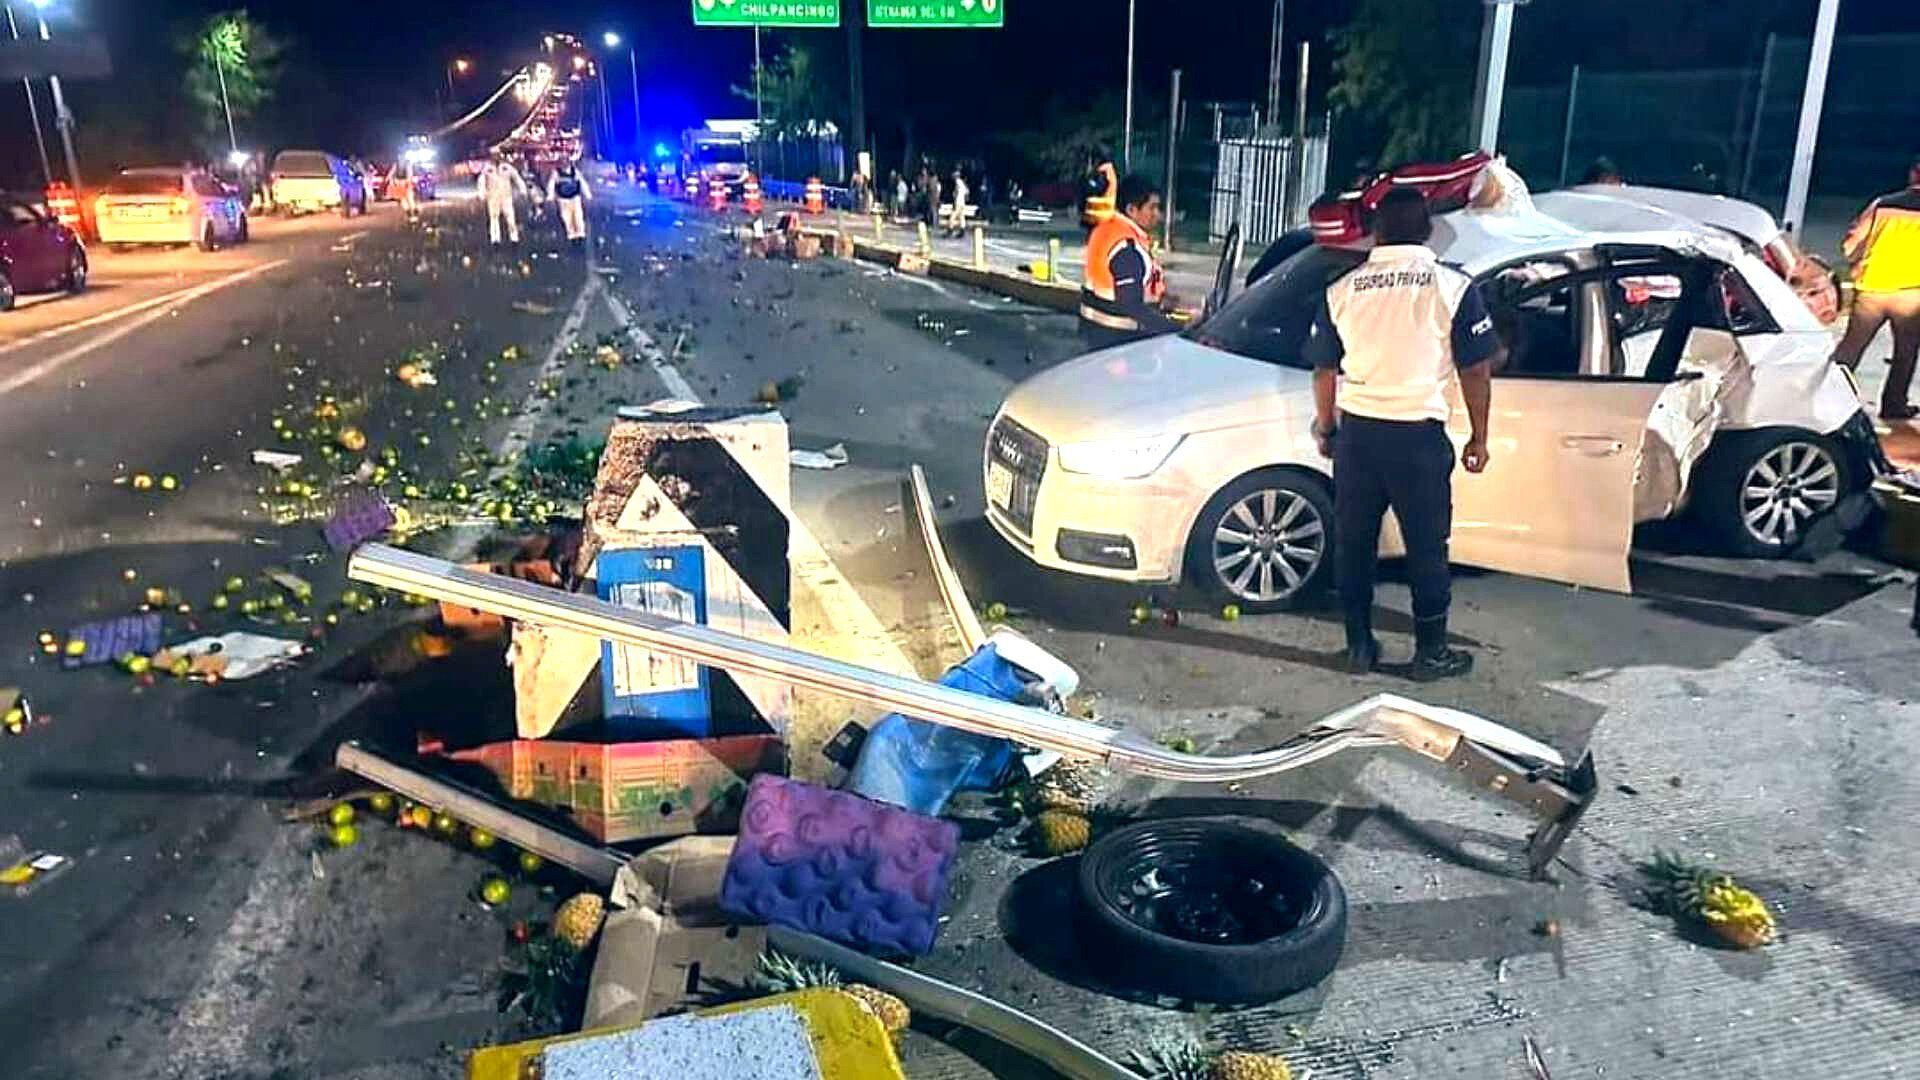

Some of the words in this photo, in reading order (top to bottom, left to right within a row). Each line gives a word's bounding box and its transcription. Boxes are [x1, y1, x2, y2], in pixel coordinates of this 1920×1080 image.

[740, 3, 835, 18] CHILPANCINGO
[1353, 272, 1396, 292] SEGURIDAD
[1397, 271, 1434, 287] PRIVADA
